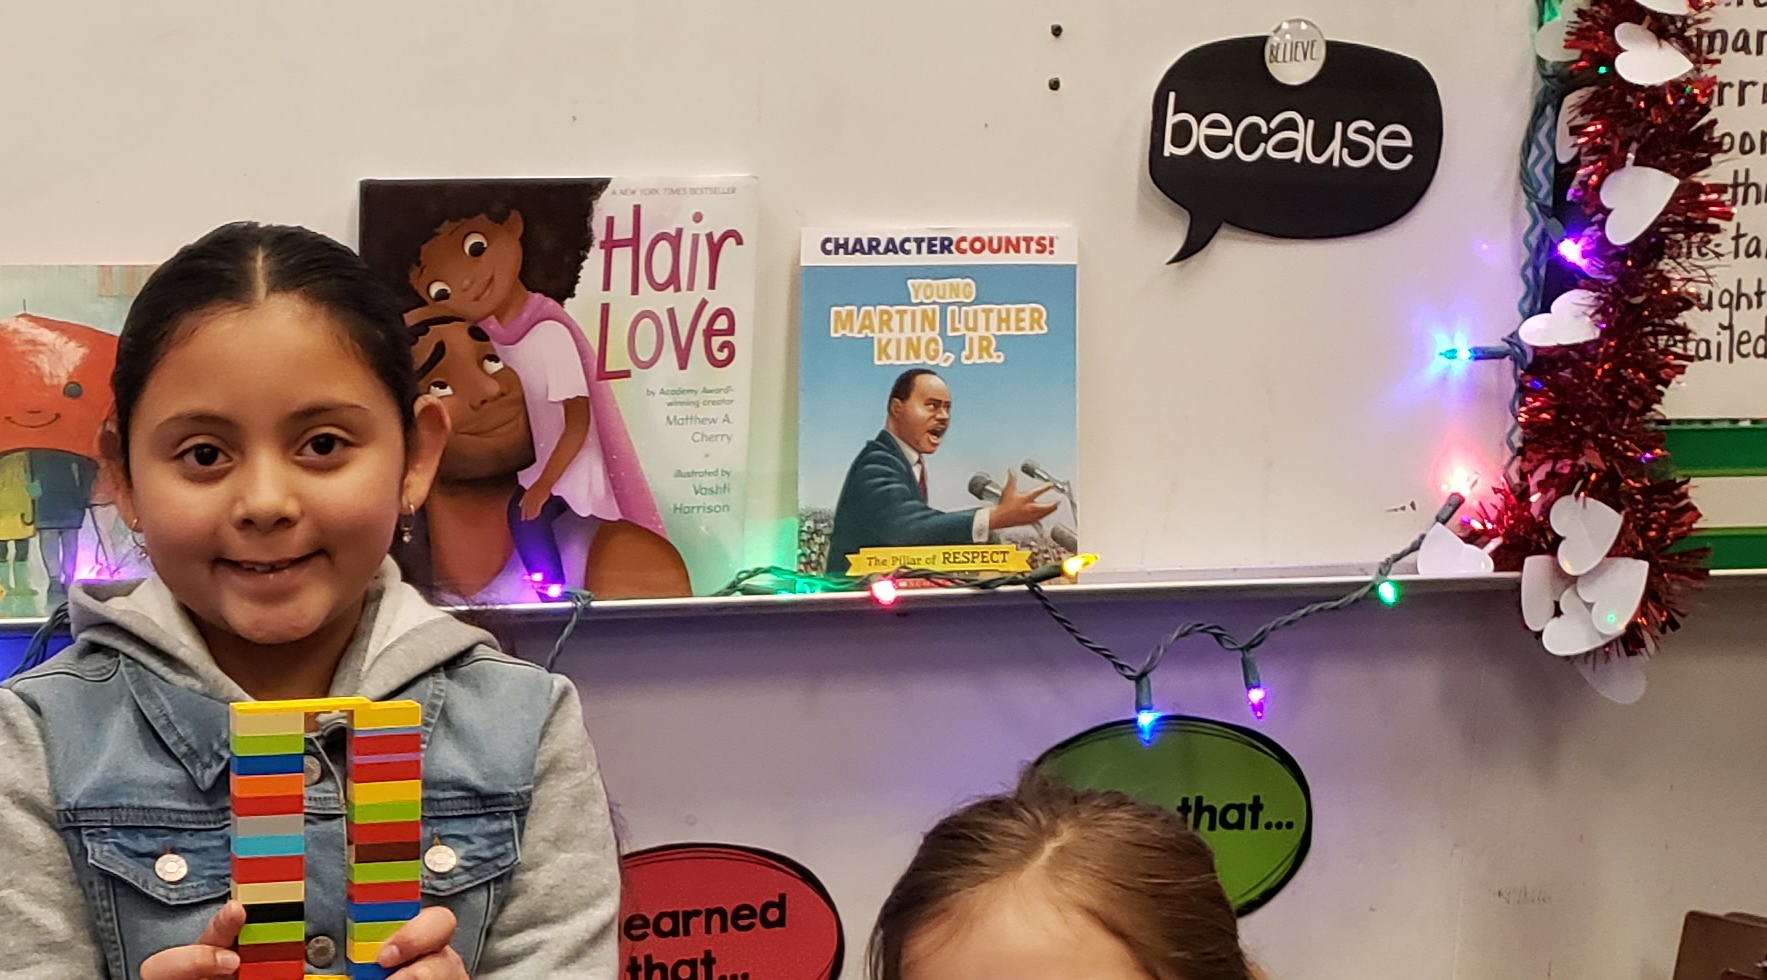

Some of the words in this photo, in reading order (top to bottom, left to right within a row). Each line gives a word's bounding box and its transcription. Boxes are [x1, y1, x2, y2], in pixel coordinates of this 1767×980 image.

[1268, 39, 1318, 63] BELIEVE
[1162, 91, 1413, 170] because
[619, 186, 636, 196] NEW
[639, 186, 660, 196] YORK
[663, 186, 688, 195] TIMES
[689, 186, 737, 195] BESTSELLER
[599, 203, 745, 296] Hair
[820, 235, 1056, 257] CHARACTERCOUNTS!
[909, 279, 975, 302] YOUNG
[832, 308, 940, 335] MARTIN
[948, 306, 1046, 334] LUTHER
[596, 297, 736, 382] Love
[875, 336, 954, 365] KING,
[963, 337, 1003, 362] JR.
[645, 388, 655, 397] by
[658, 386, 699, 397] Academy
[666, 399, 700, 409] winning
[701, 398, 735, 407] creator
[665, 413, 718, 426] Matthew
[722, 412, 733, 425] A.
[691, 430, 734, 445] Cherry
[673, 468, 720, 479] illustrated
[720, 467, 732, 478] by
[692, 482, 731, 497] Vashti
[672, 501, 731, 515] Harrison
[866, 556, 888, 567] The
[891, 554, 922, 567] Pillar
[925, 554, 937, 565] of
[942, 550, 1010, 565] RESPECT
[1176, 794, 1294, 832] that...
[619, 892, 787, 942] earned
